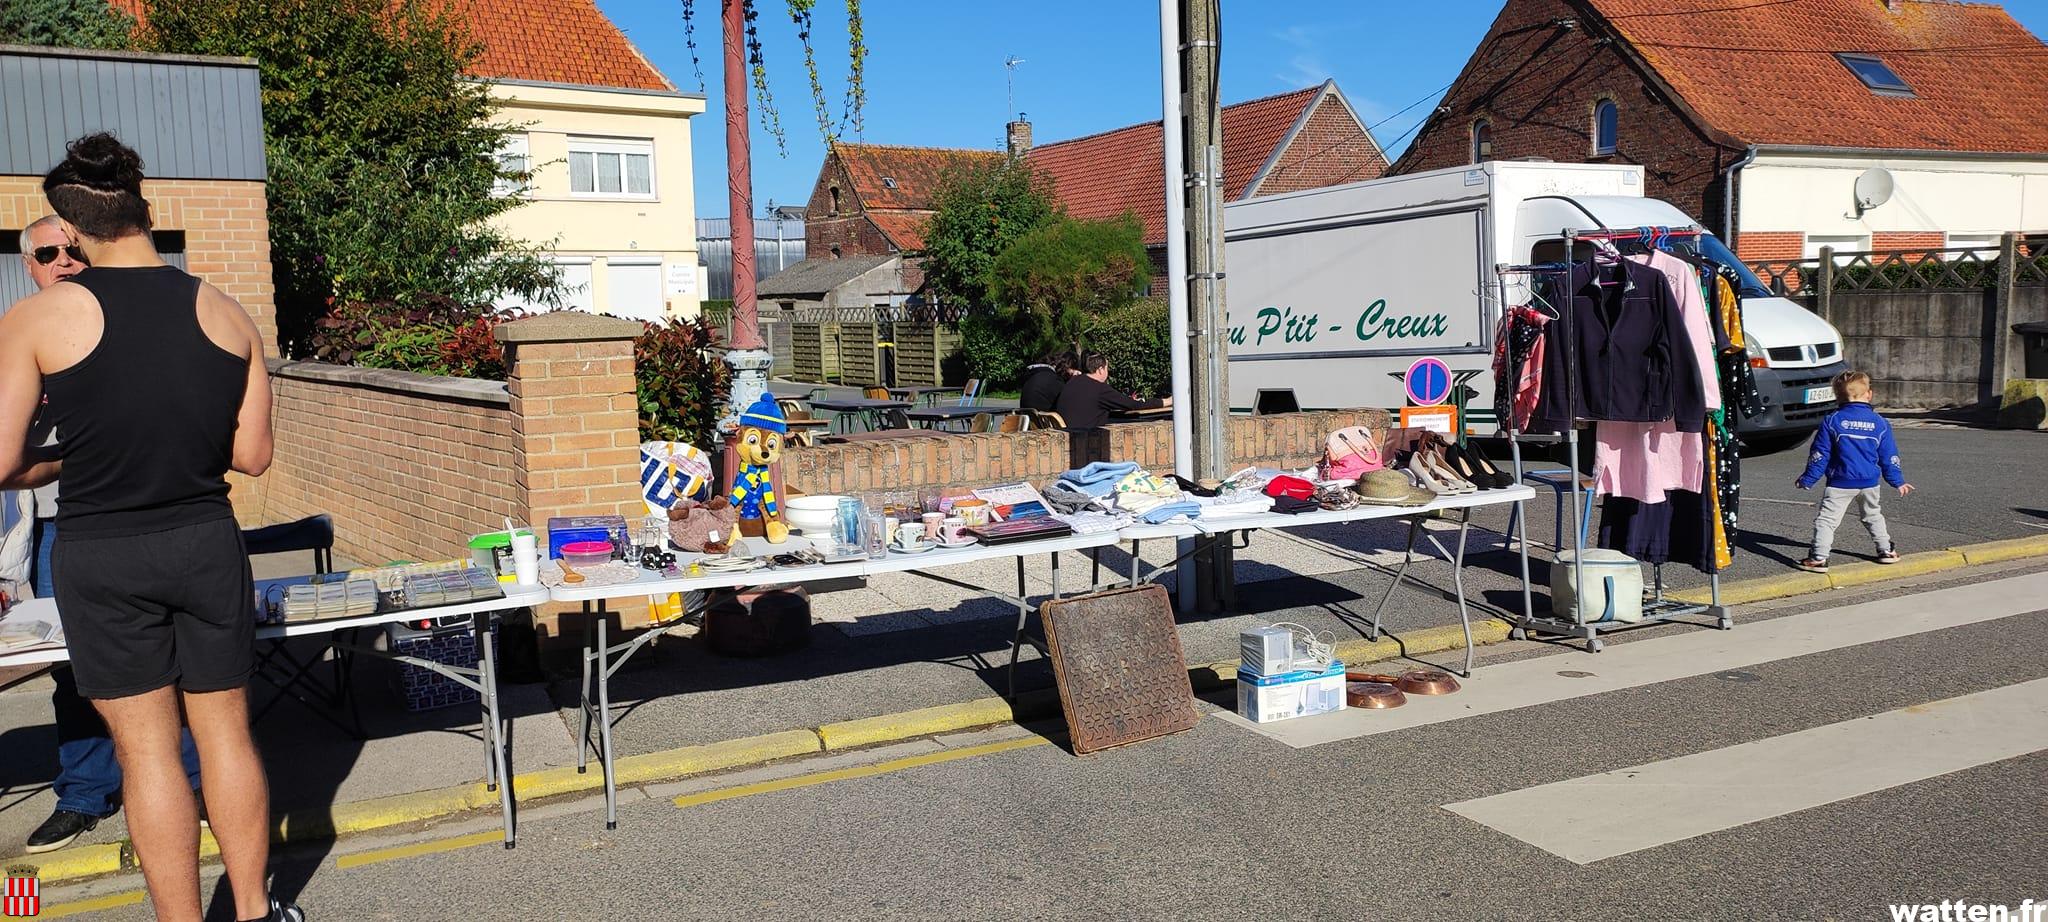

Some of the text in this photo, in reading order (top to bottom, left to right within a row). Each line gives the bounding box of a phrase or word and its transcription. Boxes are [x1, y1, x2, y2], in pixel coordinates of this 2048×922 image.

[1226, 312, 1247, 345] u
[1257, 306, 1318, 346] P'tit
[1356, 299, 1448, 341] Creux
[1849, 420, 1875, 429] YAMAHA
